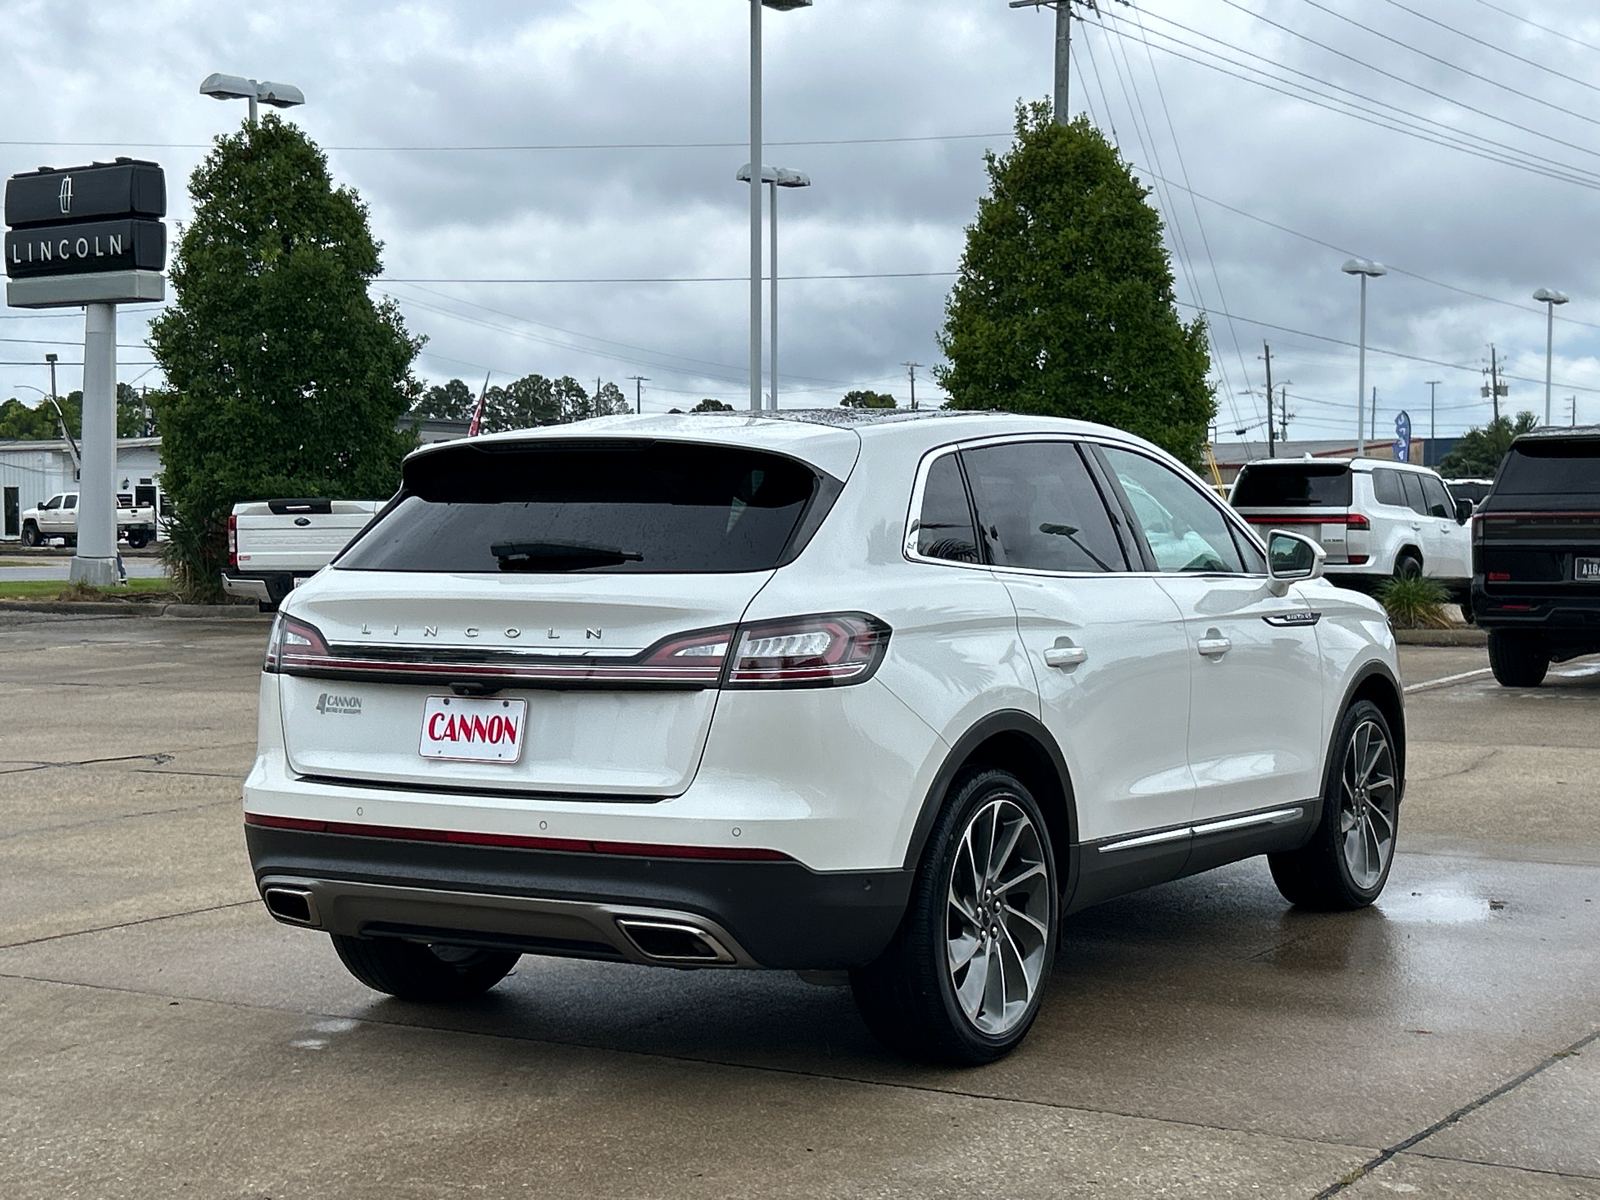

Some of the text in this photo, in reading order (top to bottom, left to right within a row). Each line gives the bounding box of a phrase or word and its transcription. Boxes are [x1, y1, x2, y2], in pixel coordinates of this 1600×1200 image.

[13, 234, 122, 264] LINCOLN
[361, 623, 602, 639] LINCOLN
[428, 712, 518, 745] CANNON
